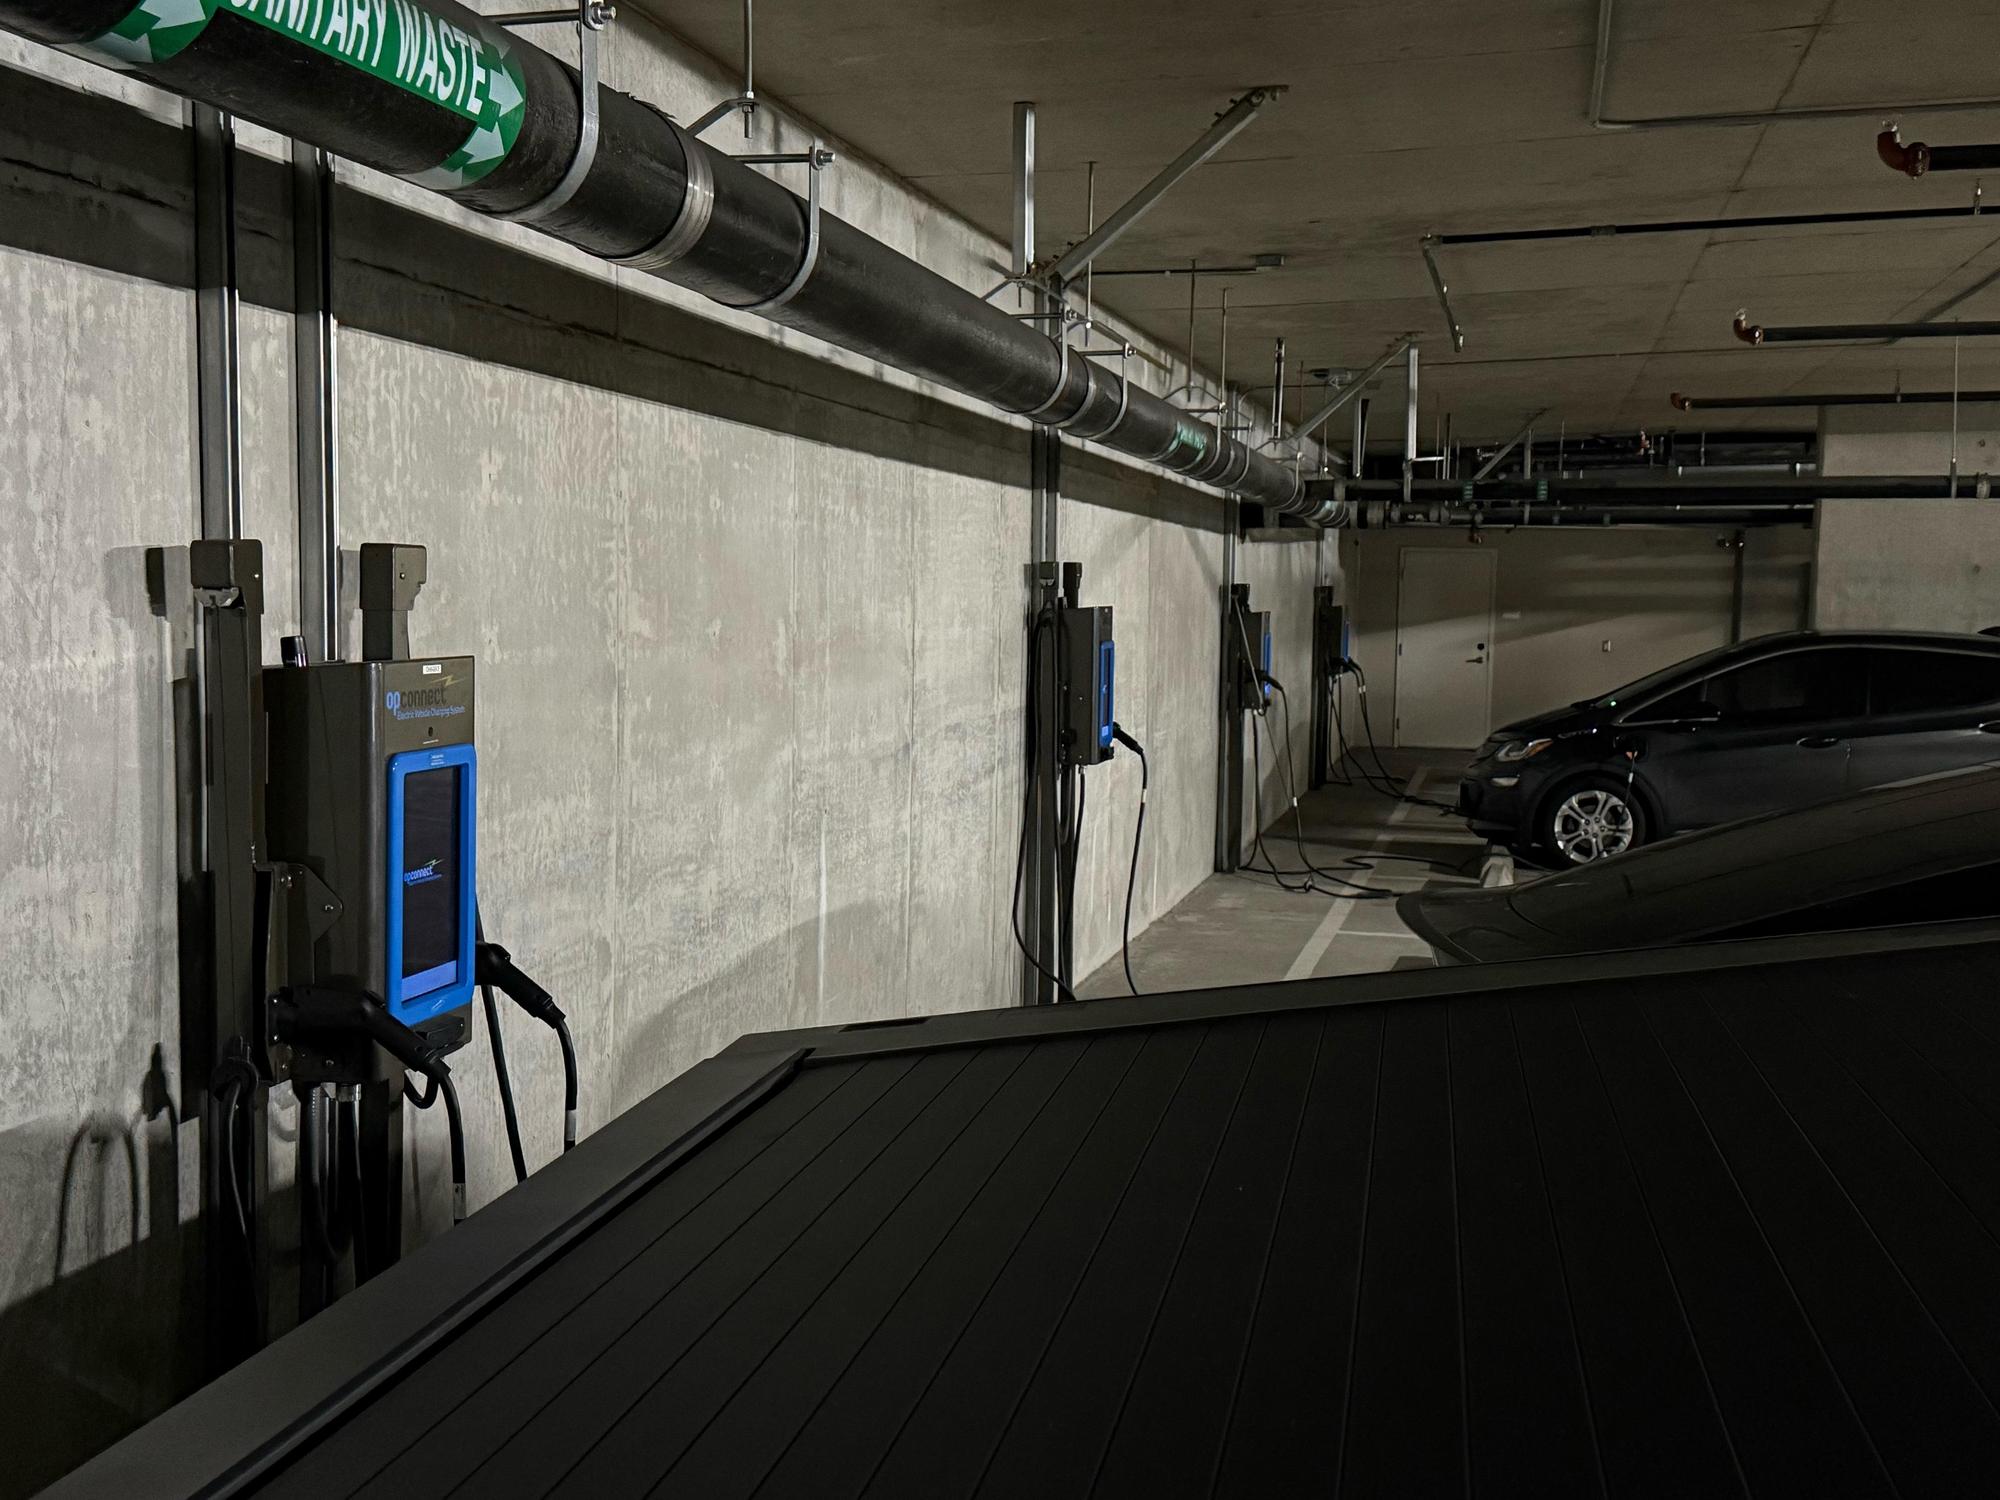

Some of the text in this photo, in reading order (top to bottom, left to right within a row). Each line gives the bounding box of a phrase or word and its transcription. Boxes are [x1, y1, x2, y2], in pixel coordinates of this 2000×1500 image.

[230, 0, 486, 115] TARY WASTE
[386, 687, 447, 716] opconnect
